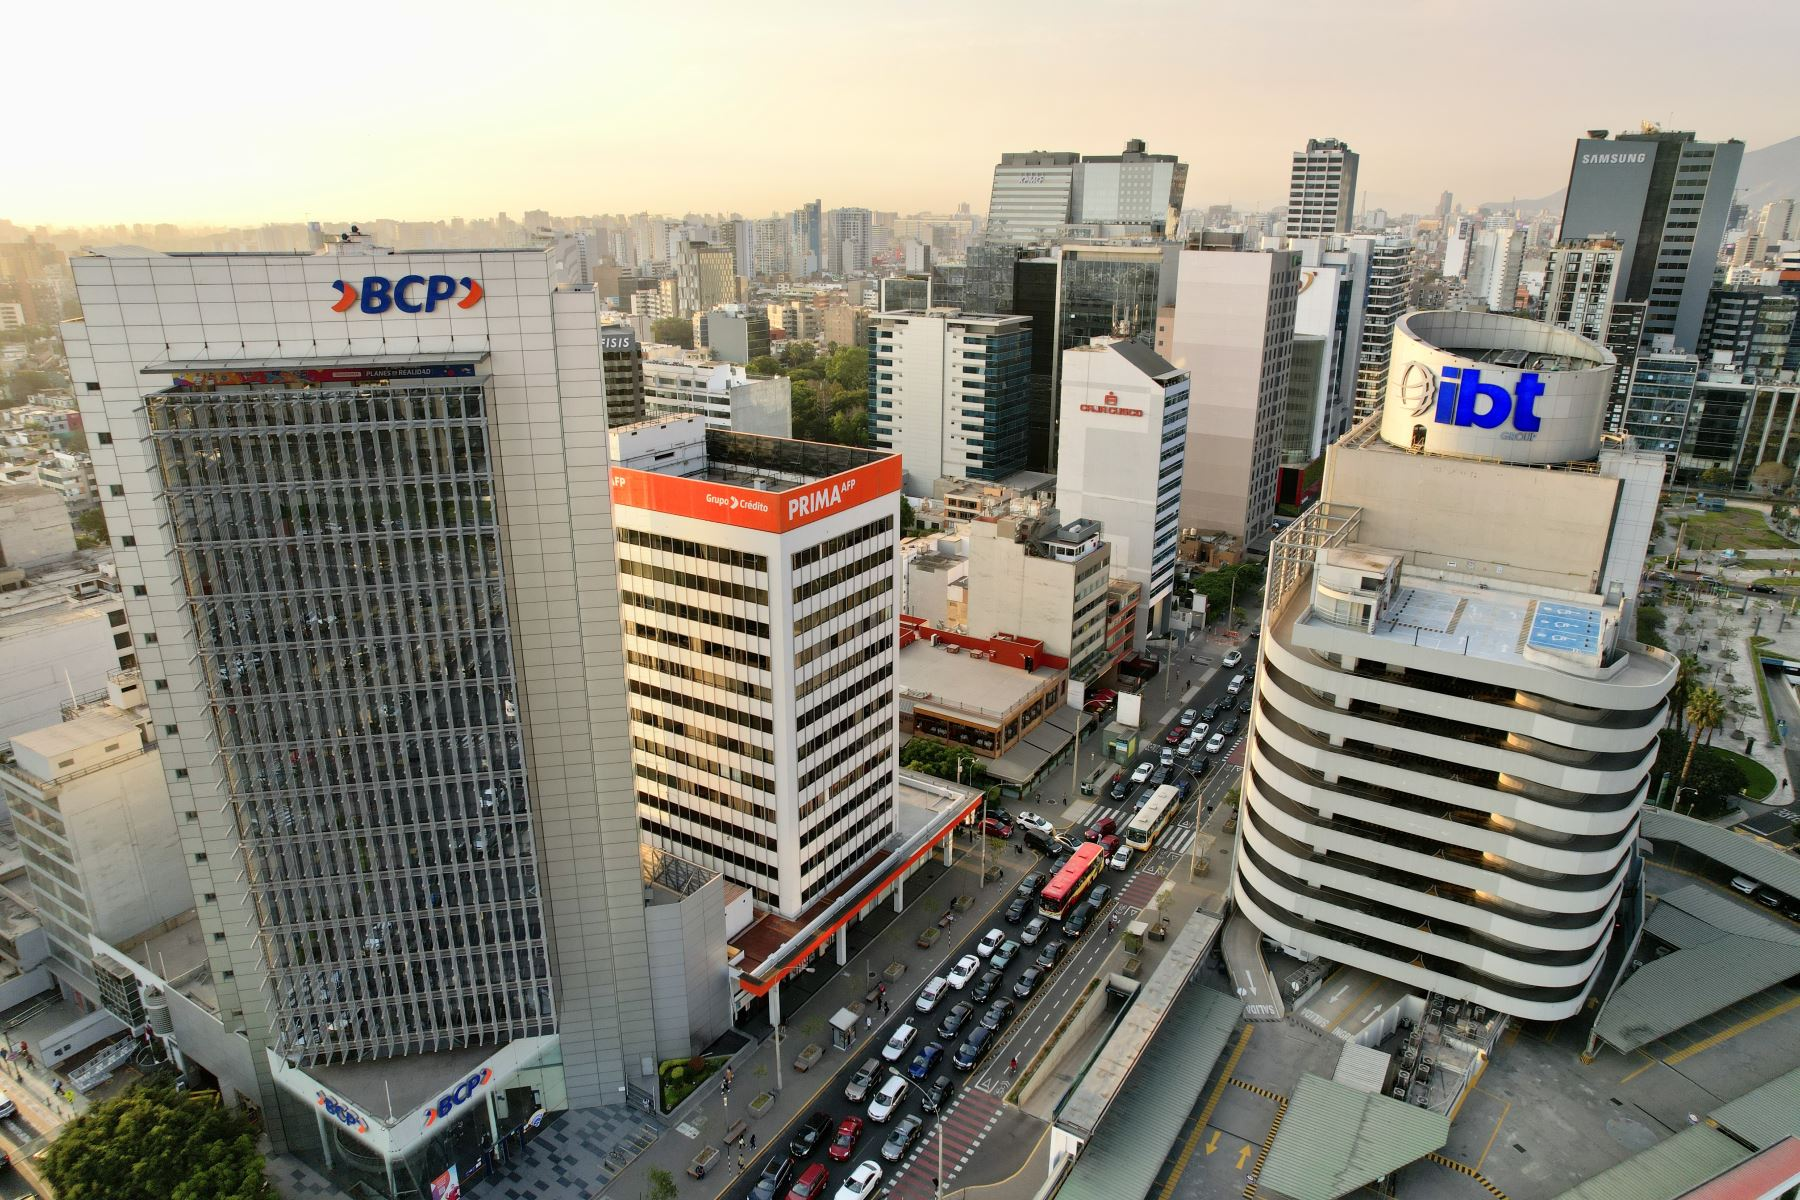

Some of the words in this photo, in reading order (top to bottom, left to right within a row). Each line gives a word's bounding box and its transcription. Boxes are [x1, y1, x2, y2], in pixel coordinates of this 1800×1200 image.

[1582, 153, 1646, 164] SAMSUNG
[360, 275, 457, 314] BCP
[1434, 366, 1545, 432] ibt
[1500, 431, 1537, 442] GROUP
[706, 493, 730, 507] Grupo
[739, 498, 769, 513] Crédito
[788, 484, 842, 521] PRIMA
[841, 478, 857, 493] AFP
[1245, 1004, 1277, 1016] SALIDA
[437, 1073, 481, 1119] BCP
